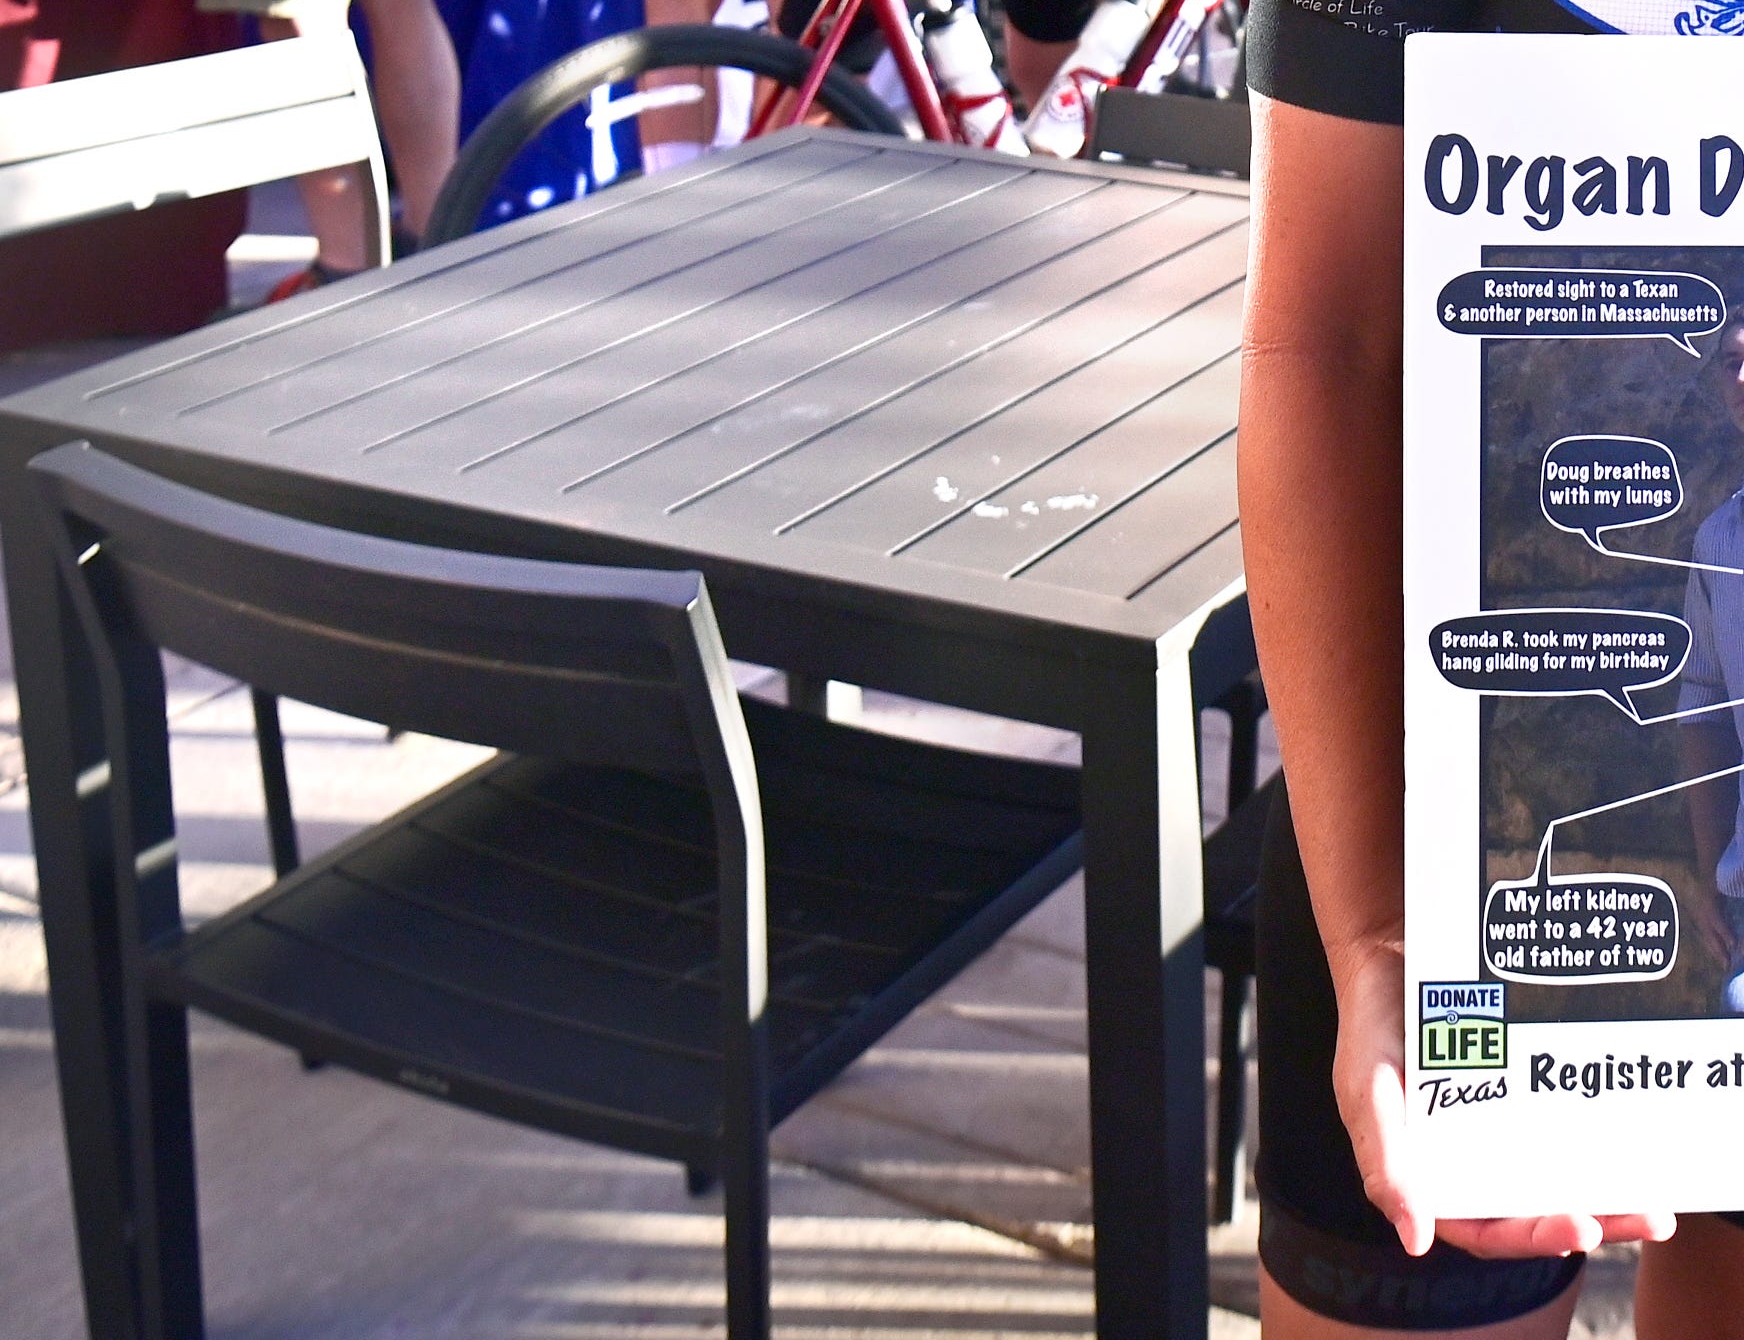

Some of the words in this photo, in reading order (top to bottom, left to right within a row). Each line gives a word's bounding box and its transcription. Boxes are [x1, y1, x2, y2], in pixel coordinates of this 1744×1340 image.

[1424, 133, 1671, 232] Organ
[1484, 278, 1554, 299] Restored
[1557, 278, 1596, 302] sight
[1599, 281, 1616, 298] to
[1619, 283, 1629, 298] a
[1632, 279, 1678, 298] Texan
[1444, 303, 1457, 322] &
[1459, 302, 1522, 322] another
[1525, 306, 1578, 326] person
[1581, 304, 1597, 322] in
[1600, 302, 1718, 322] Massachusetts
[1546, 461, 1590, 484] Doug
[1593, 460, 1671, 481] breathes
[1549, 485, 1590, 505] with
[1594, 489, 1622, 508] my
[1626, 485, 1672, 508] lungs
[1441, 630, 1499, 648] Brenda
[1502, 630, 1519, 648] R.
[1522, 629, 1559, 648] took
[1562, 633, 1588, 650] my
[1592, 632, 1666, 651] pancreas
[1442, 652, 1482, 673] hang
[1485, 651, 1539, 673] gliding
[1542, 651, 1567, 670] for
[1570, 655, 1596, 672] my
[1599, 650, 1670, 672] birthday
[1504, 889, 1541, 916] My
[1545, 889, 1582, 912] left
[1586, 888, 1654, 914] kidney
[1488, 919, 1538, 941] went
[1543, 919, 1565, 940] to
[1569, 921, 1582, 939] a
[1586, 915, 1617, 940] 42
[1622, 920, 1669, 942] year
[1494, 945, 1525, 968] old
[1529, 944, 1595, 968] father
[1599, 943, 1621, 967] of
[1626, 945, 1664, 966] two
[1427, 989, 1500, 1008] DONATE
[1428, 1027, 1500, 1061] LIFE
[1530, 1052, 1694, 1099] Register
[1418, 1075, 1508, 1116] Texas
